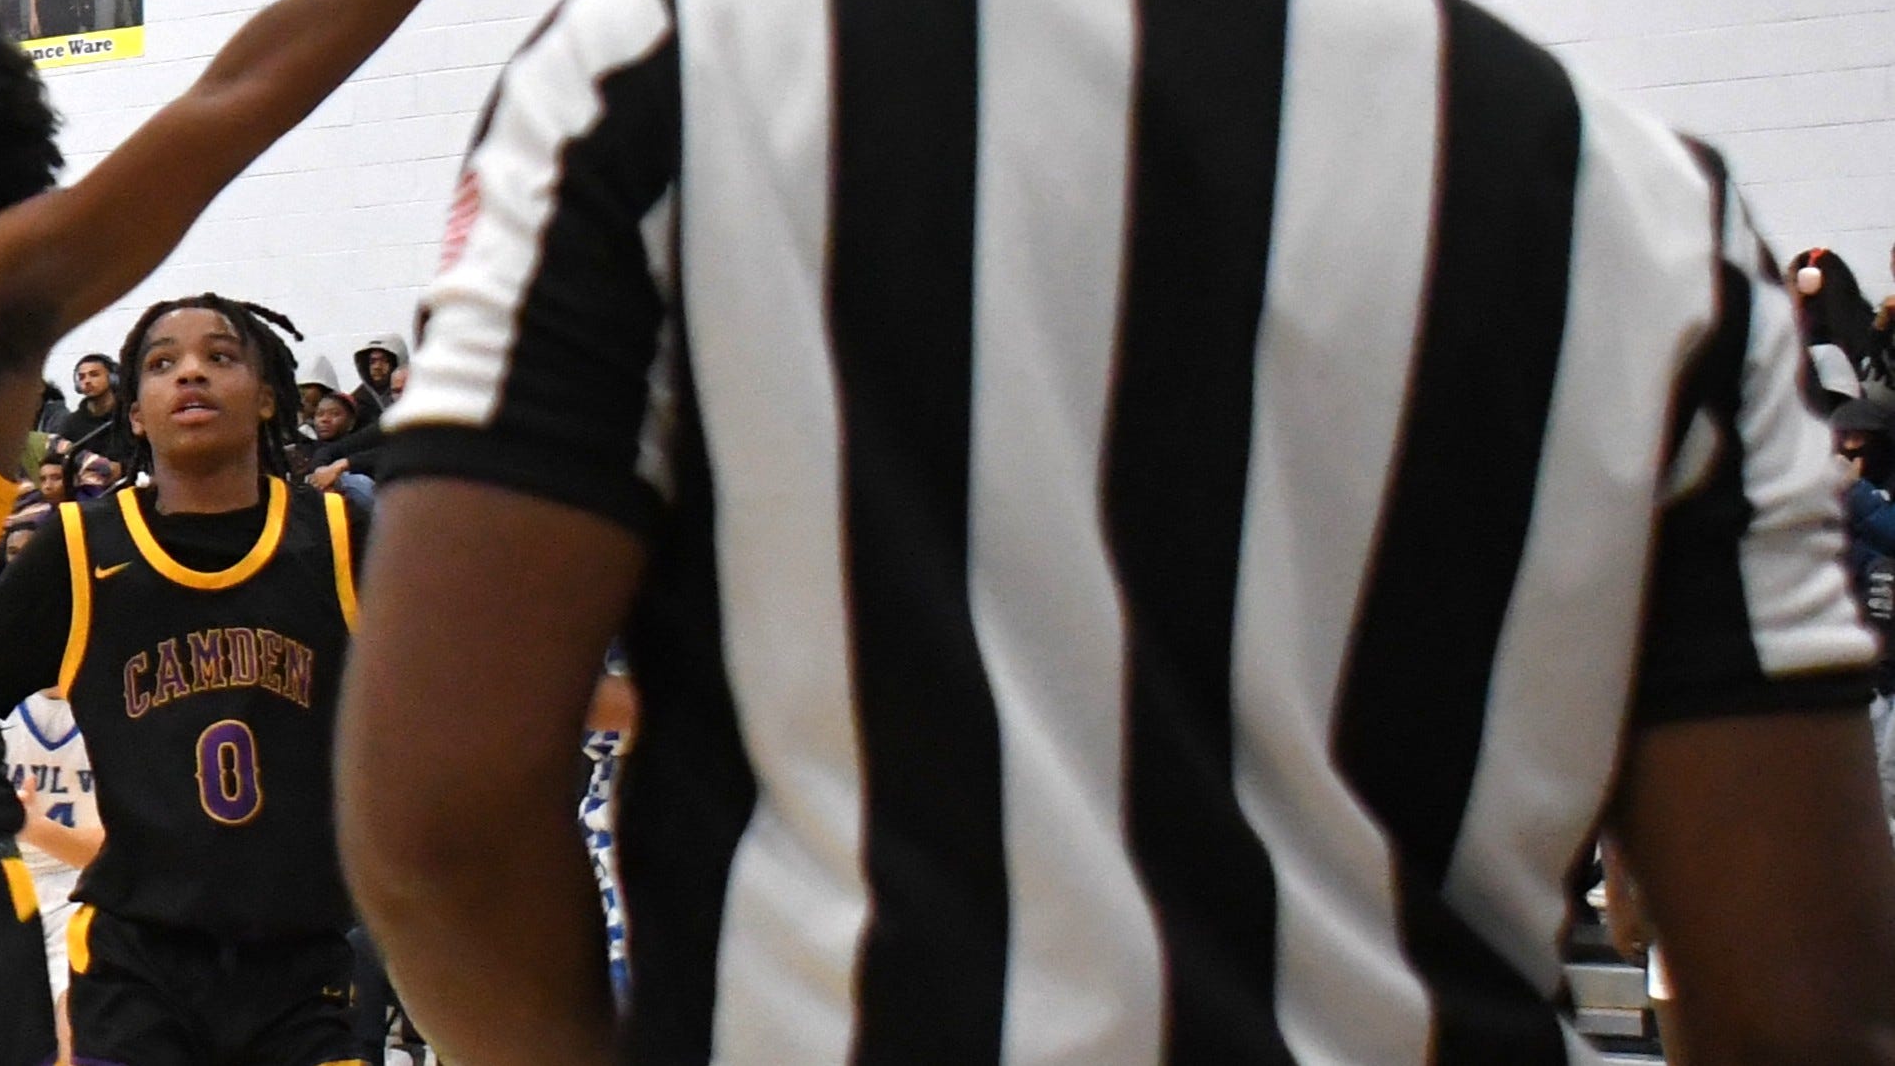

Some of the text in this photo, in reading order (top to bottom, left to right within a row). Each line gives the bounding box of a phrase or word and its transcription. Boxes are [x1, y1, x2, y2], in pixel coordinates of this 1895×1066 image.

[26, 38, 112, 61] ance Ware
[122, 627, 314, 719] CAMDEN
[12, 762, 68, 794] AUL
[195, 719, 264, 824] 0
